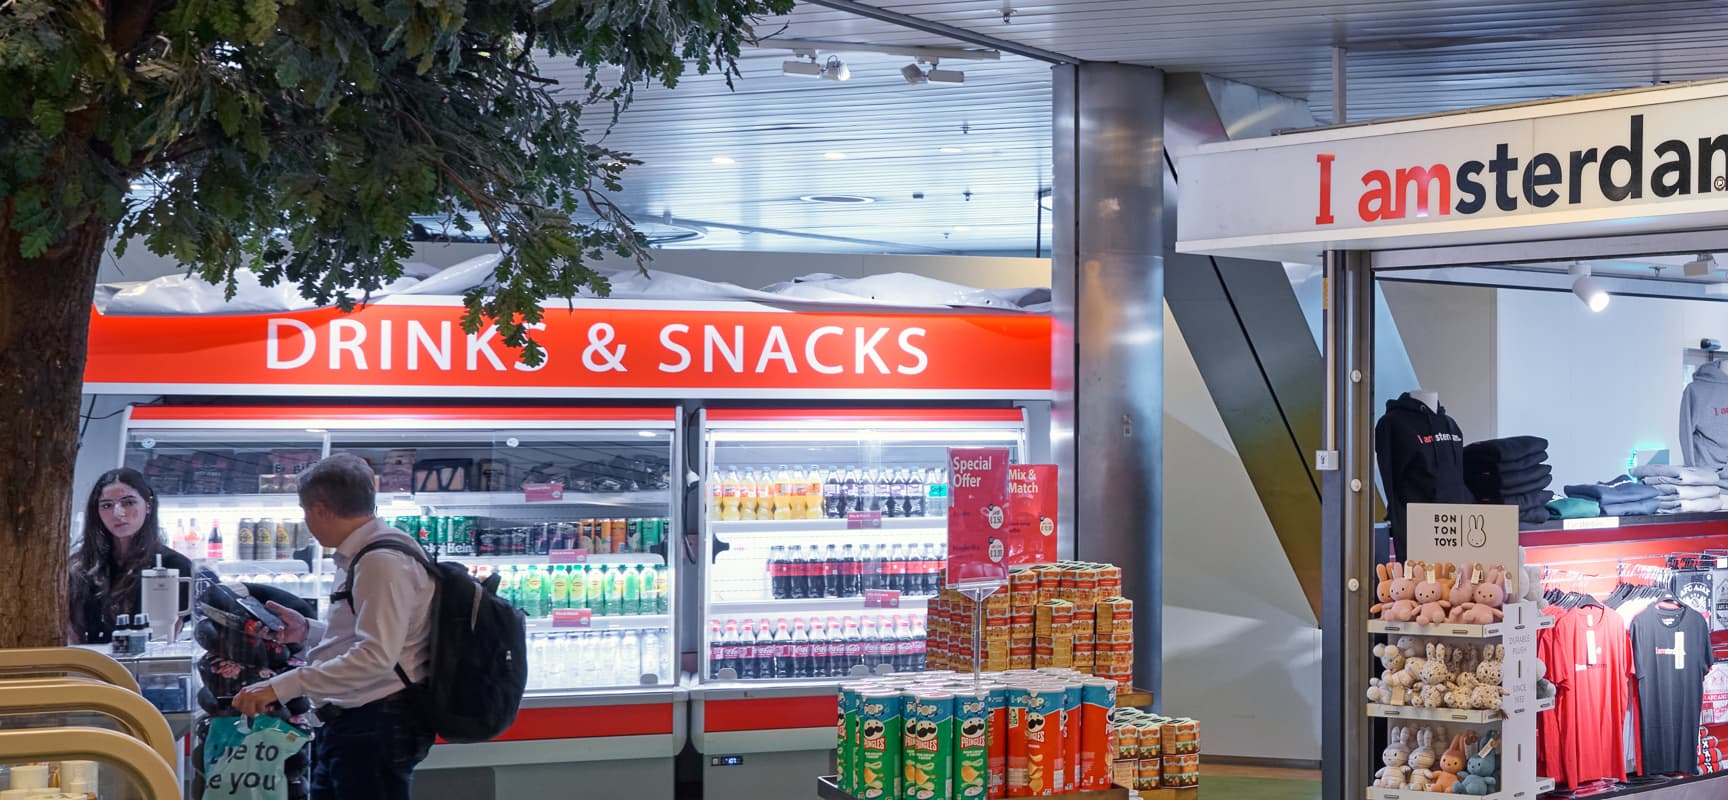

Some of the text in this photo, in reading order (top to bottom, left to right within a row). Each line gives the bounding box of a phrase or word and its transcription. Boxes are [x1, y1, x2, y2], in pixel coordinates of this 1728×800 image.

[1316, 153, 1335, 225] I
[266, 317, 928, 375] DRINKS & SNACKS
[953, 456, 992, 474] Special
[953, 474, 981, 488] Offer
[1009, 469, 1037, 480] Mix &
[1009, 482, 1038, 494] Match
[1434, 514, 1457, 523] BON
[1434, 526, 1457, 534] TON
[1434, 538, 1457, 547] TOYS
[255, 741, 279, 761] to
[229, 771, 276, 795] you
